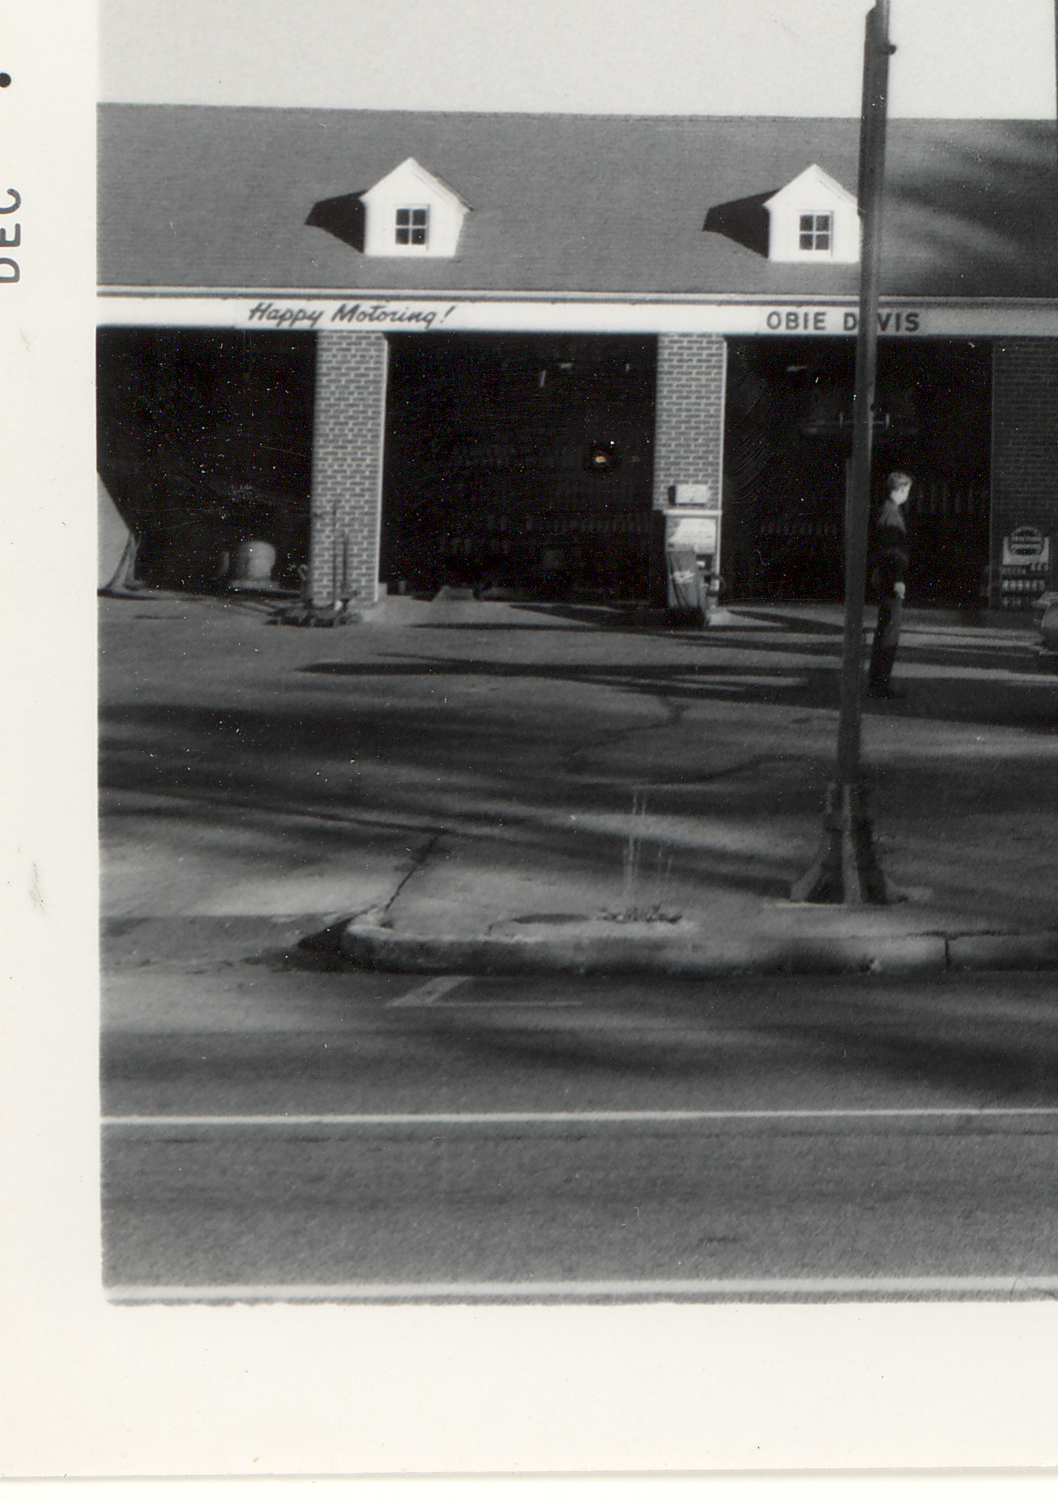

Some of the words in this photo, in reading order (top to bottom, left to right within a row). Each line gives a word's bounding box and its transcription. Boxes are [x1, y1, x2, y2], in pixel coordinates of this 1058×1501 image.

[249, 301, 324, 328] Happy
[331, 303, 456, 331] Motoring!
[766, 311, 827, 331] OBIE
[843, 312, 920, 333] DVIS
